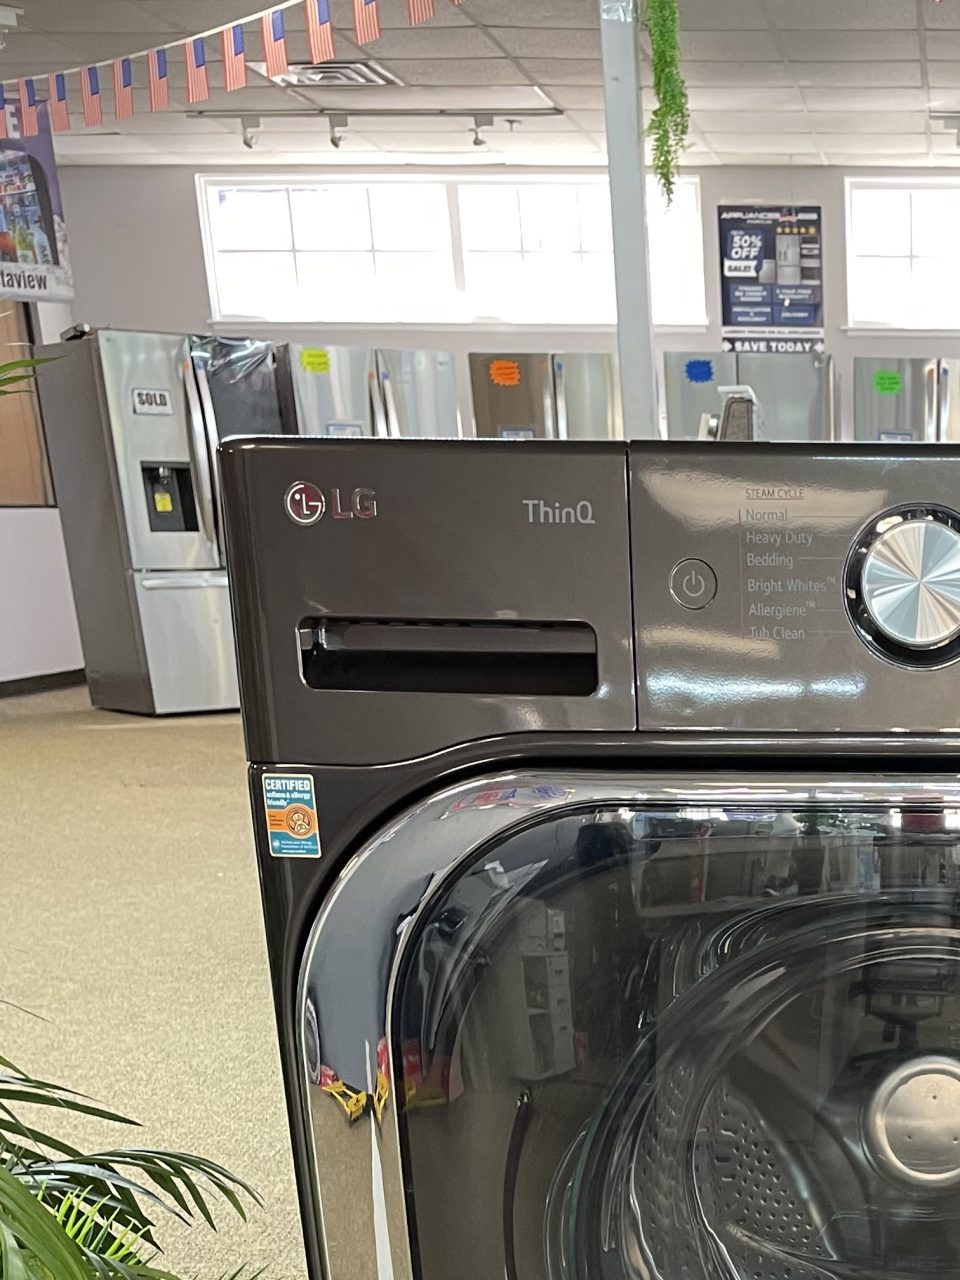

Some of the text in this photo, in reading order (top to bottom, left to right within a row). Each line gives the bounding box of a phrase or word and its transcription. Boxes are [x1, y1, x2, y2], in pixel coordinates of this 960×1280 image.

[732, 234, 763, 248] 50%
[730, 247, 760, 259] OFF
[734, 341, 812, 352] SAVE TODAY
[137, 392, 167, 406] SOLD
[745, 488, 804, 498] STEAM CYCLE
[331, 487, 377, 519] LG
[522, 499, 596, 525] ThinQ
[746, 509, 788, 521] Normal
[746, 531, 813, 547] Heavy Duty
[747, 553, 794, 569] Bedding
[747, 579, 783, 595] Bright
[750, 627, 805, 640] Tub Clean
[265, 780, 310, 791] CERTIFIED
